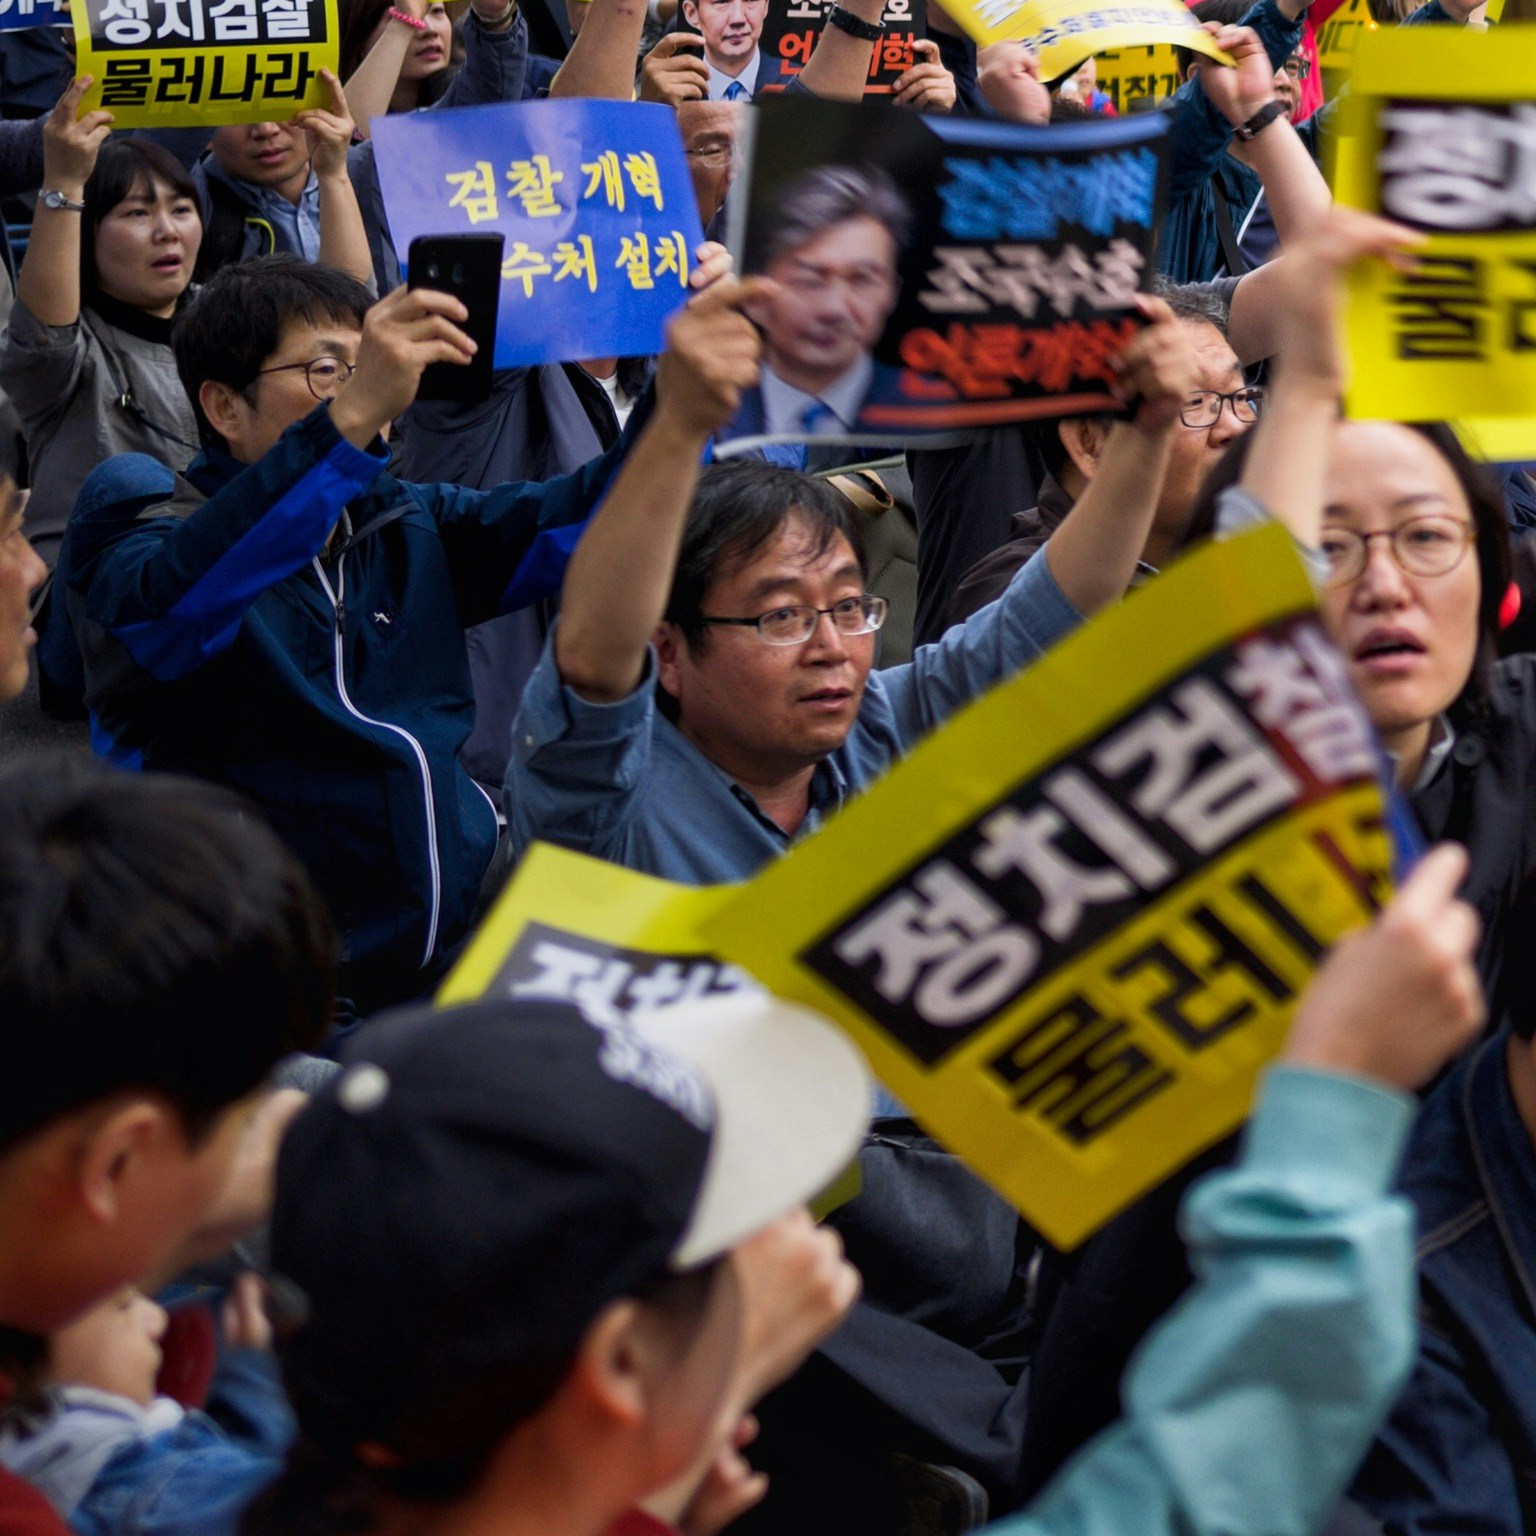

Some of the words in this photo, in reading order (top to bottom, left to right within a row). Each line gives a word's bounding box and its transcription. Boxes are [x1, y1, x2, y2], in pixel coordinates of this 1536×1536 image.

[99, 50, 317, 108] 물러나라
[445, 152, 566, 227] 검찰
[580, 147, 666, 214] 개혁
[614, 228, 691, 292] 설치
[835, 624, 1379, 1029] 정치검찰
